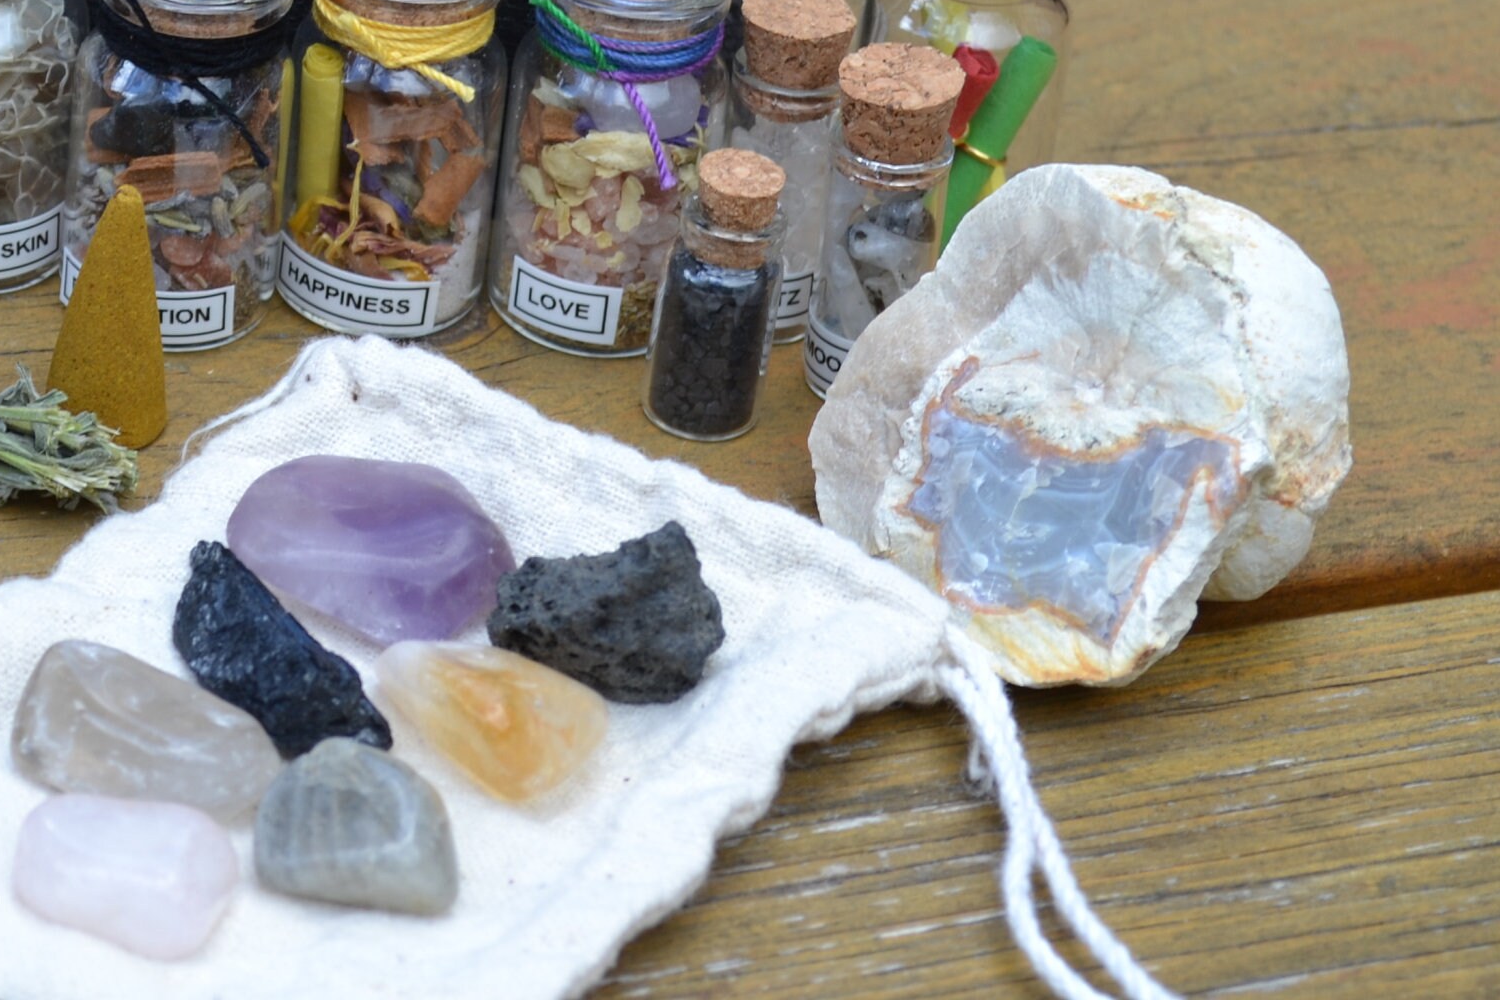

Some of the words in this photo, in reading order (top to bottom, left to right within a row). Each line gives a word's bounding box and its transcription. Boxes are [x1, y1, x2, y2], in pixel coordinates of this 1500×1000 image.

[1, 230, 49, 259] SKIN
[288, 261, 411, 315] HAPPINESS
[527, 287, 591, 320] LOVE
[778, 289, 802, 308] TZ
[159, 307, 211, 325] TION
[806, 334, 842, 373] MOO
